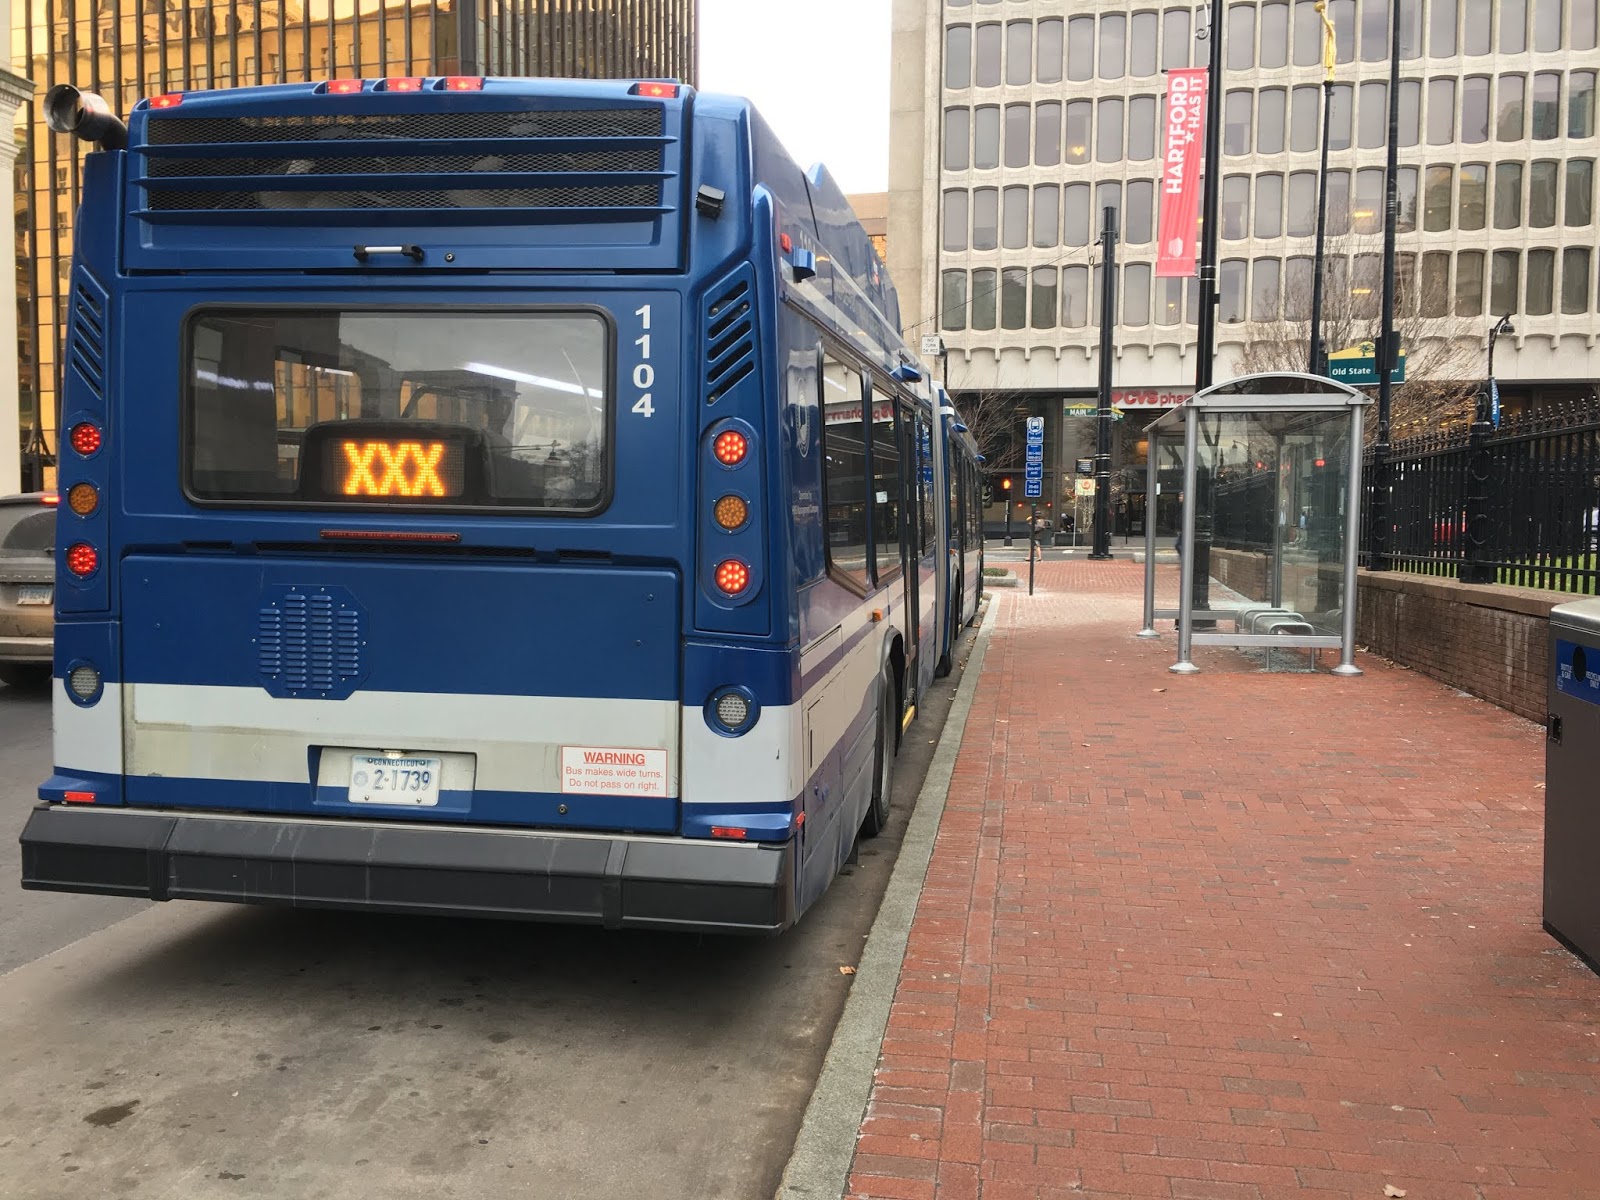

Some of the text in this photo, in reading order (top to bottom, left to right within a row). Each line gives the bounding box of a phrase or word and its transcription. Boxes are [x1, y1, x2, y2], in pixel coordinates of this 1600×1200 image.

[1188, 76, 1203, 129] HAS IT
[1165, 76, 1188, 194] HARTFORD
[631, 304, 655, 418] 1104
[1332, 367, 1371, 376] Old State
[1123, 389, 1193, 406] CVS phar
[343, 442, 445, 496] XXX
[373, 758, 418, 767] CONNECTICUT
[583, 751, 645, 765] WARNING
[565, 766, 663, 778] Bus makes wide turns.
[569, 778, 581, 787] Do
[584, 779, 598, 787] not
[600, 781, 621, 789] pass
[637, 781, 660, 792] right.
